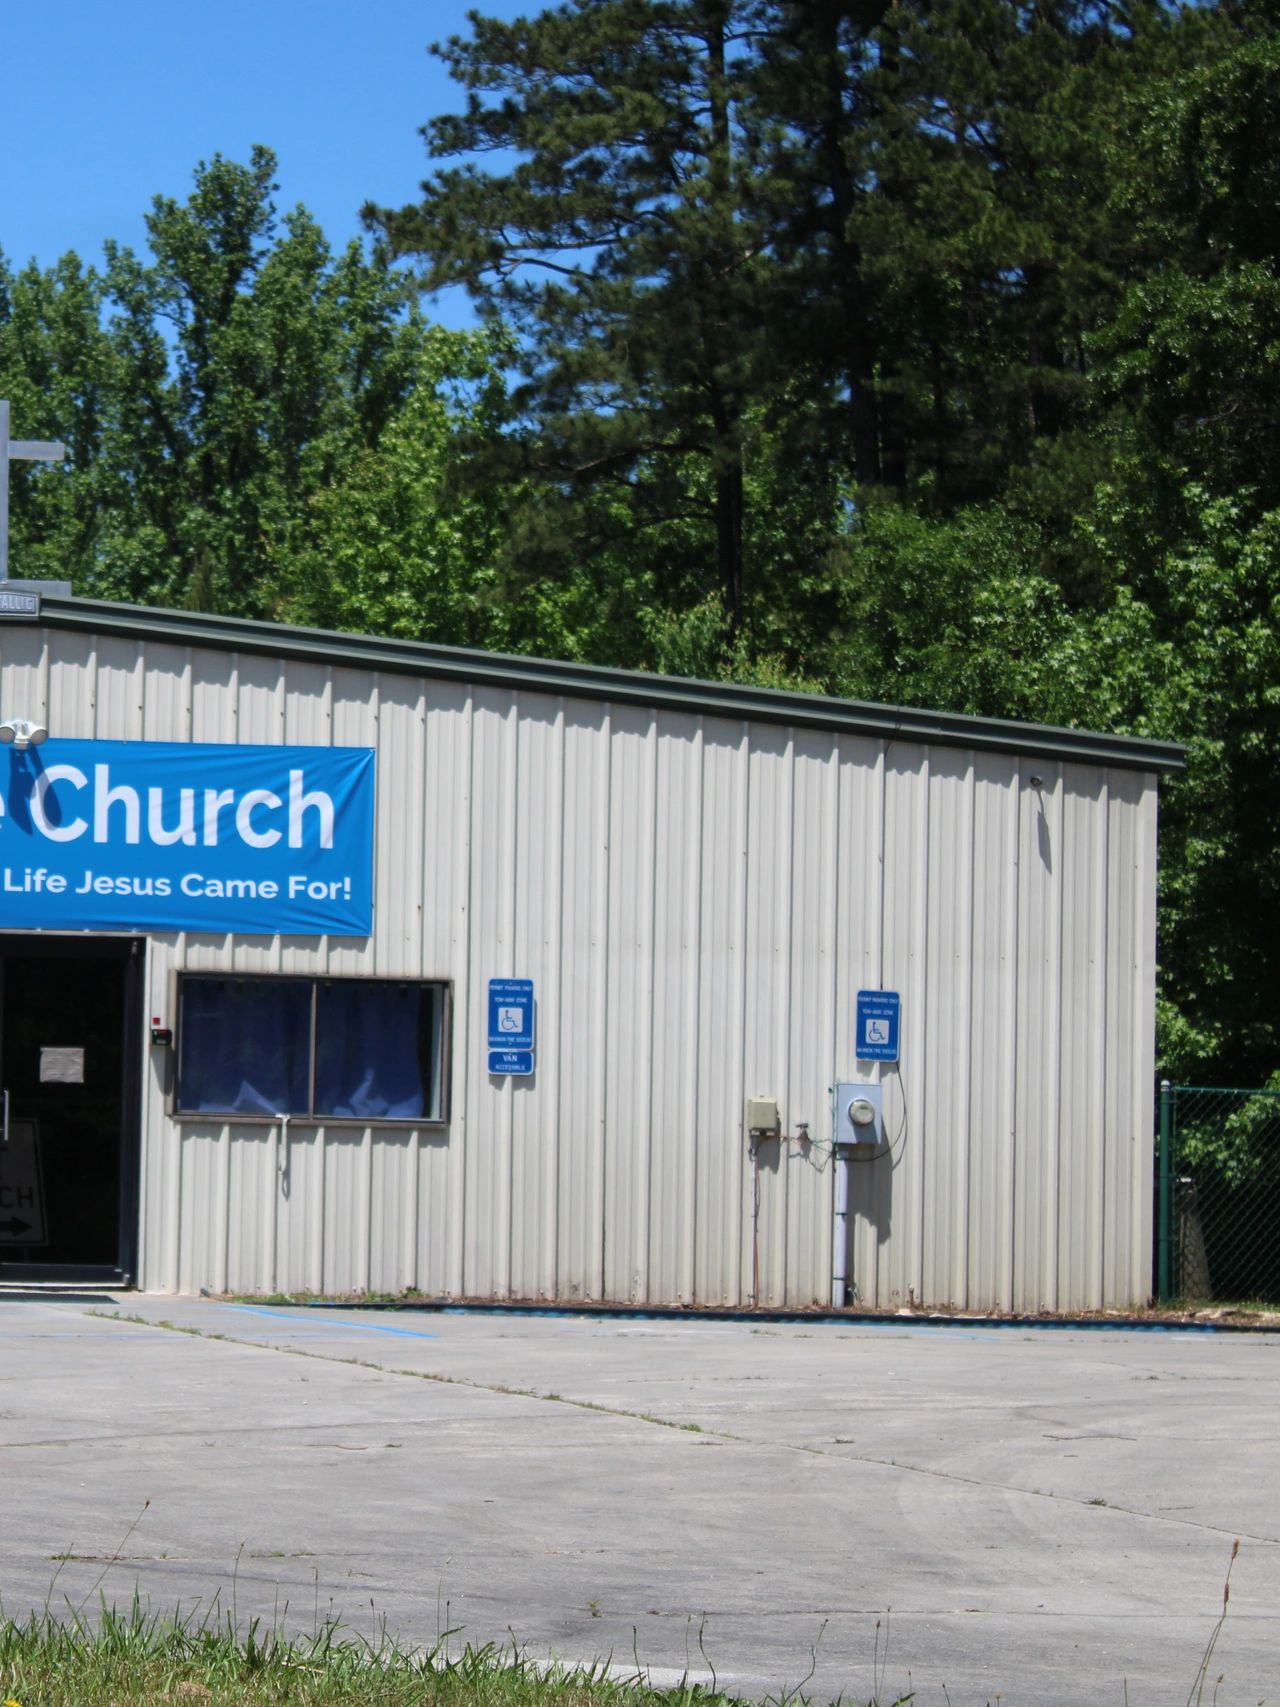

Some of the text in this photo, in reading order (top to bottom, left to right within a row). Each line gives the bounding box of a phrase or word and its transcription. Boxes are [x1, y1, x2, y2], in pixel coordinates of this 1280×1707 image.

[31, 763, 334, 849] Church
[5, 869, 66, 892] Life
[76, 871, 171, 895] Jesus
[181, 874, 278, 898] Came
[289, 876, 350, 899] For!
